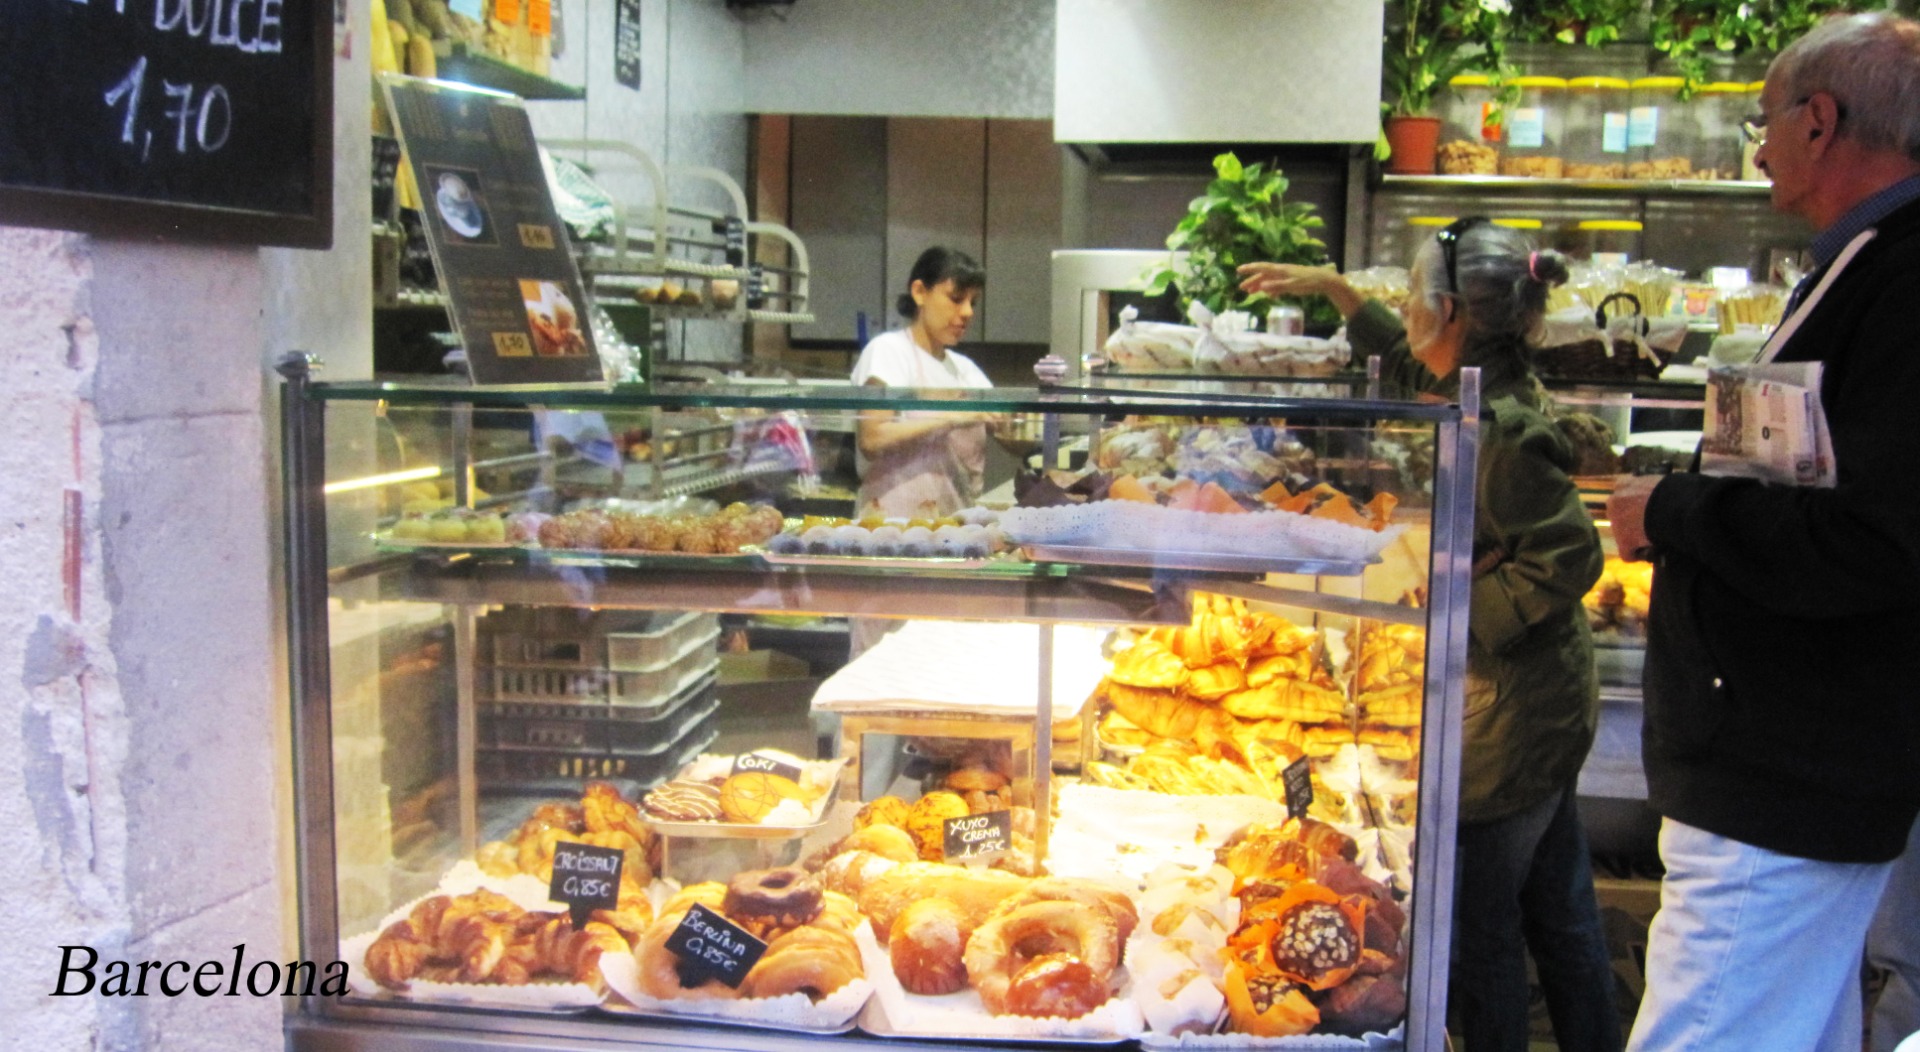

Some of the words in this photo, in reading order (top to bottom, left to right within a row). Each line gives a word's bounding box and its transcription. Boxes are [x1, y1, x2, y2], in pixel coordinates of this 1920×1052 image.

[154, 0, 283, 53] DULCE
[104, 55, 232, 163] 1,70
[949, 817, 989, 836] XUXO
[962, 826, 1000, 843] CREMA
[563, 876, 612, 898] 0,85€
[685, 937, 738, 972] 0,85€
